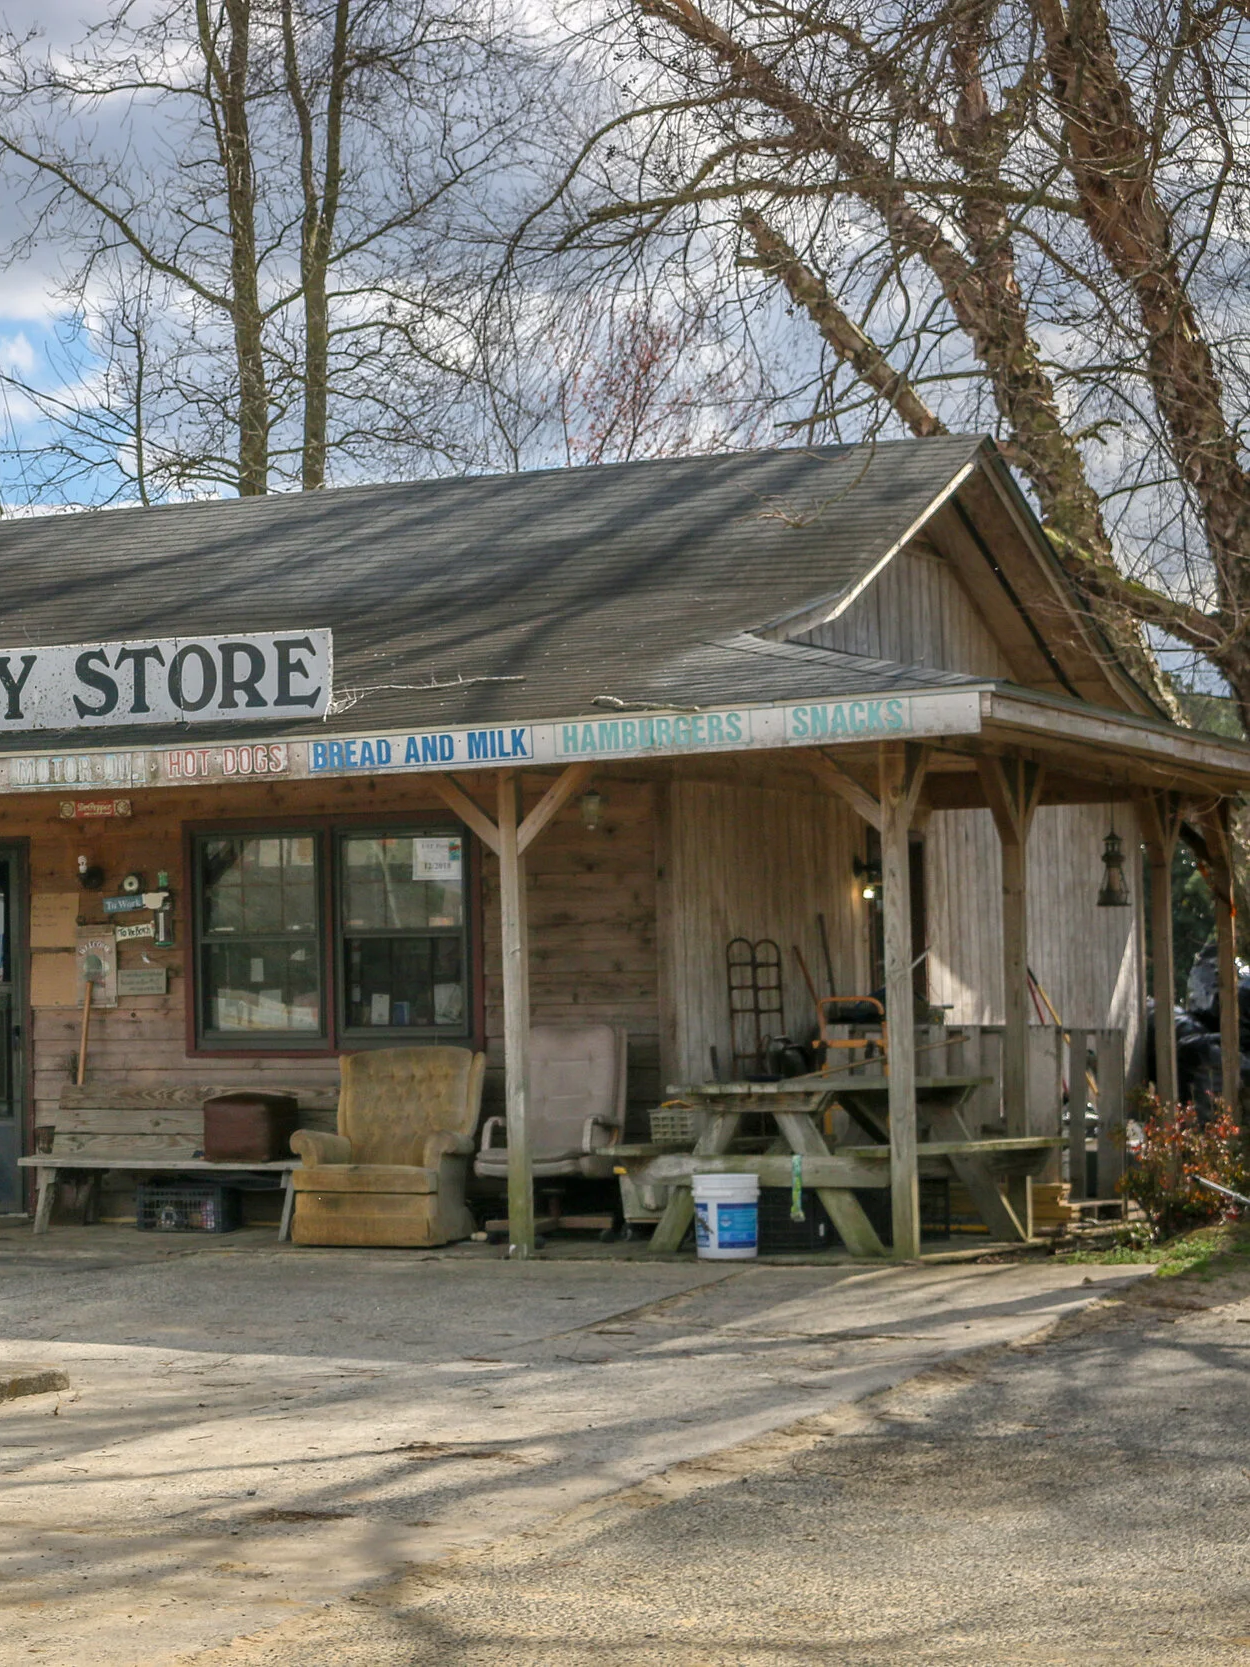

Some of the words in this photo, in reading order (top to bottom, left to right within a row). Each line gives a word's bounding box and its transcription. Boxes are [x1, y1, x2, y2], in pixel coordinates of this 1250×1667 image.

[72, 636, 323, 720] STORE
[561, 712, 744, 755] HAMBURGERS
[792, 699, 903, 738] SNACKS
[168, 750, 211, 778] HOT
[223, 745, 283, 776] DOGS
[312, 740, 392, 769] BREAD
[404, 734, 455, 764] AND
[466, 728, 527, 761] MILK
[17, 755, 92, 784] MOTOR
[117, 898, 141, 909] Work
